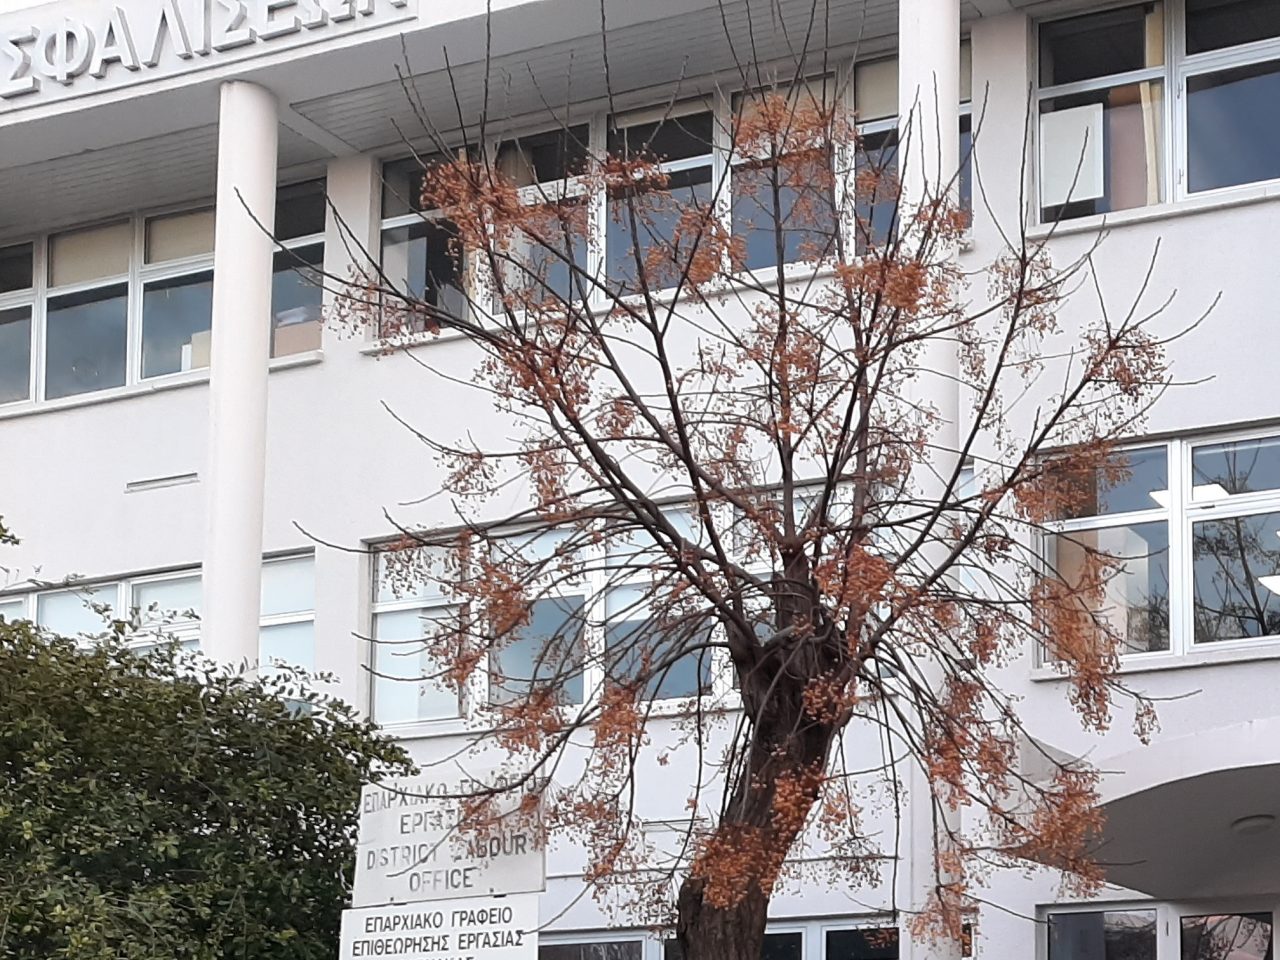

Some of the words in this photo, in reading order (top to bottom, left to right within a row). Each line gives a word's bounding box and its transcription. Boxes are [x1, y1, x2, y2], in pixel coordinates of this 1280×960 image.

[0, 0, 407, 98] ΣΦΑΛΙΣΕ
[409, 867, 474, 892] OFFICE
[365, 912, 443, 933] ΕΠΑΡΧΙΑΚΟ
[451, 907, 513, 928] ΓΡΑΦΕΙΟ
[352, 935, 450, 957] ΕΠΙΘΕΩΡΗΣΗΣ
[458, 930, 524, 950] ΕΡΓΑΣΙΑΣ
